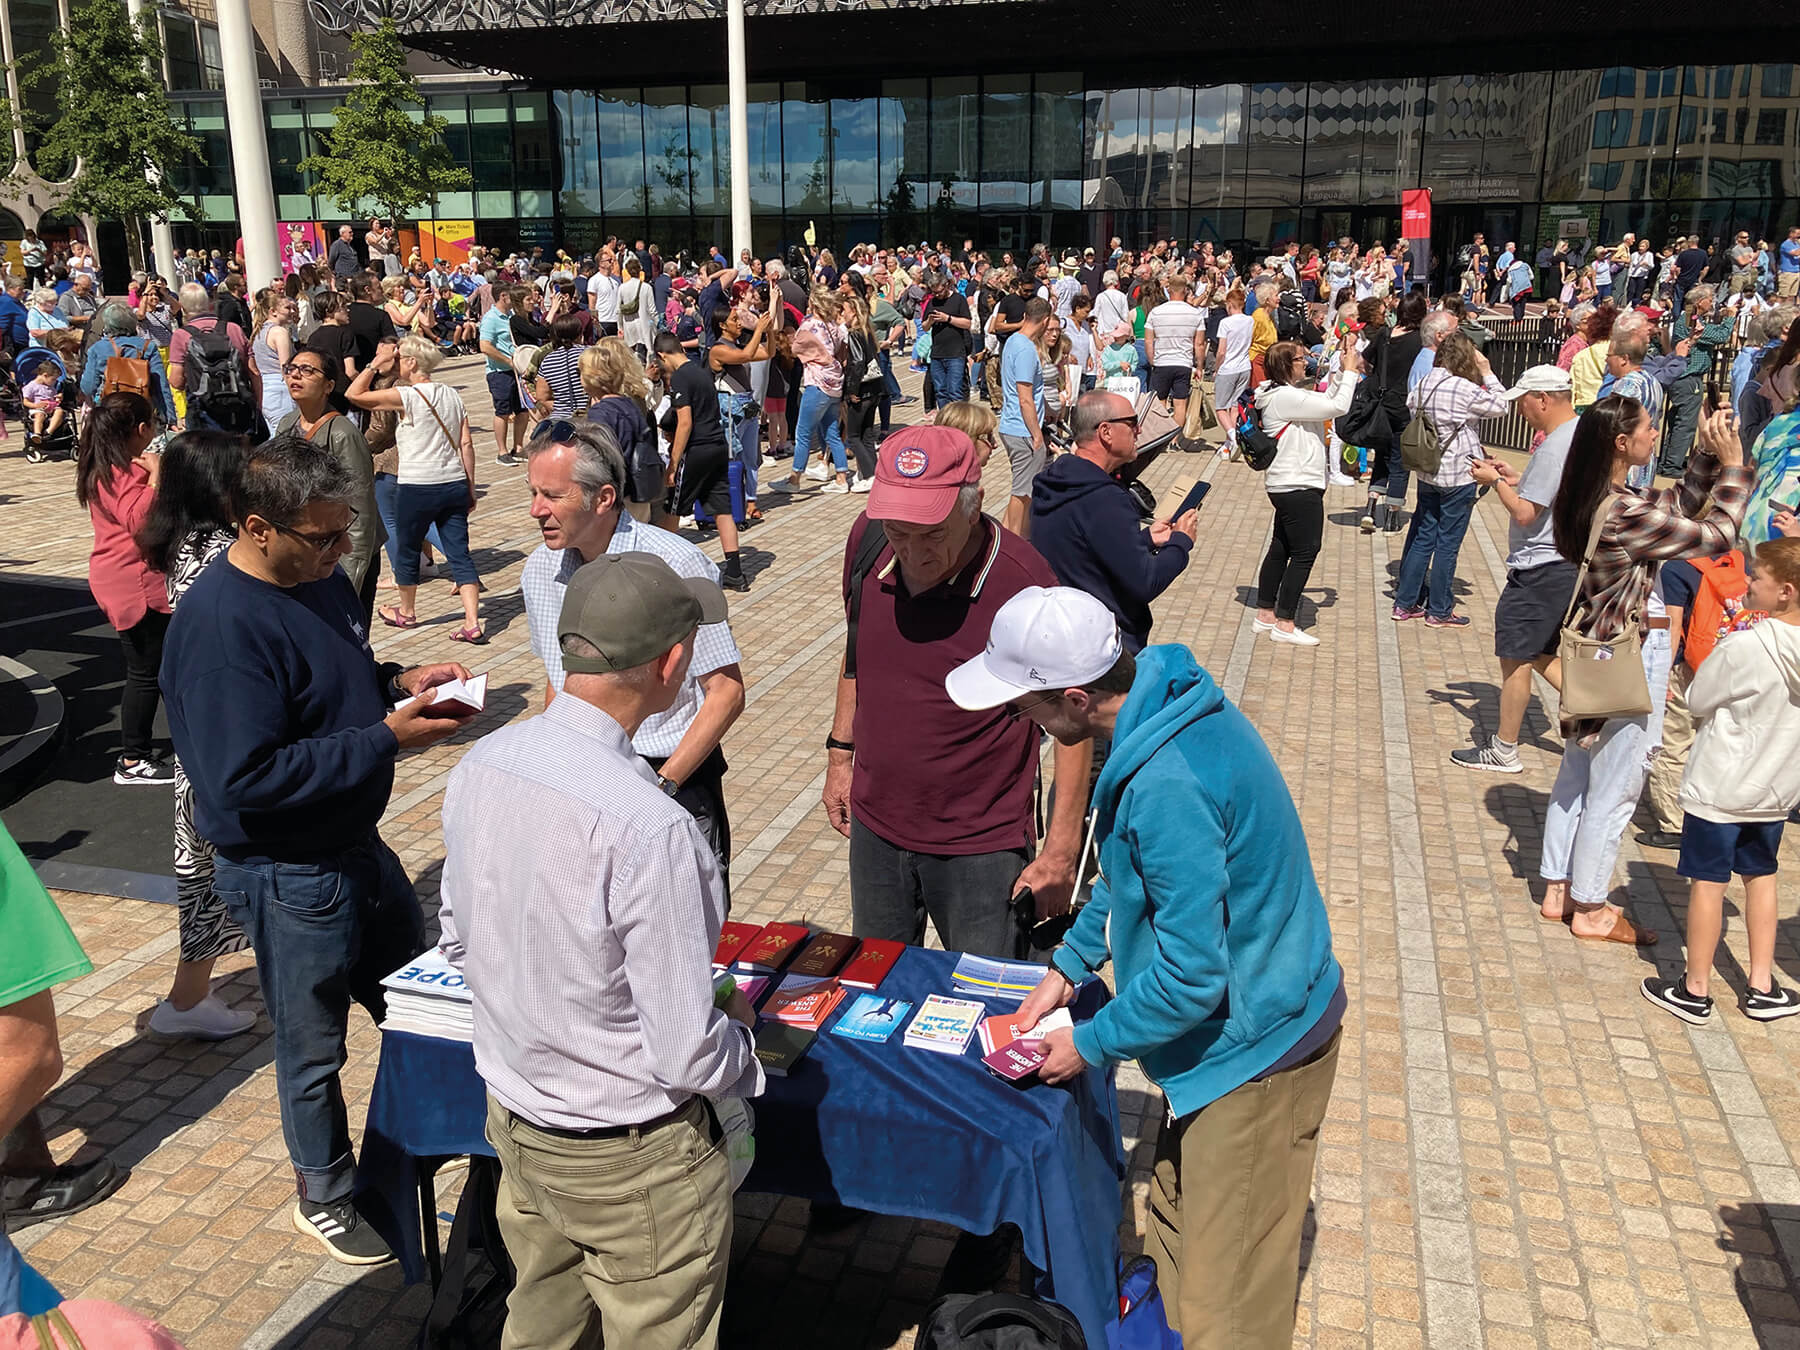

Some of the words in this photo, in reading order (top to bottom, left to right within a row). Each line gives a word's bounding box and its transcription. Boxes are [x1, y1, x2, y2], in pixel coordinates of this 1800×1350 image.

[1449, 179, 1465, 188] THE
[1467, 178, 1503, 188] LIBRARY
[1462, 188, 1520, 198] BIRMINGHAM
[396, 967, 471, 991] OPE
[834, 1025, 854, 1034] GOD
[936, 1022, 970, 1034] Enjoy
[865, 1031, 887, 1039] TURN
[1005, 1048, 1036, 1068] ANSWER
[1008, 1062, 1026, 1073] THE
